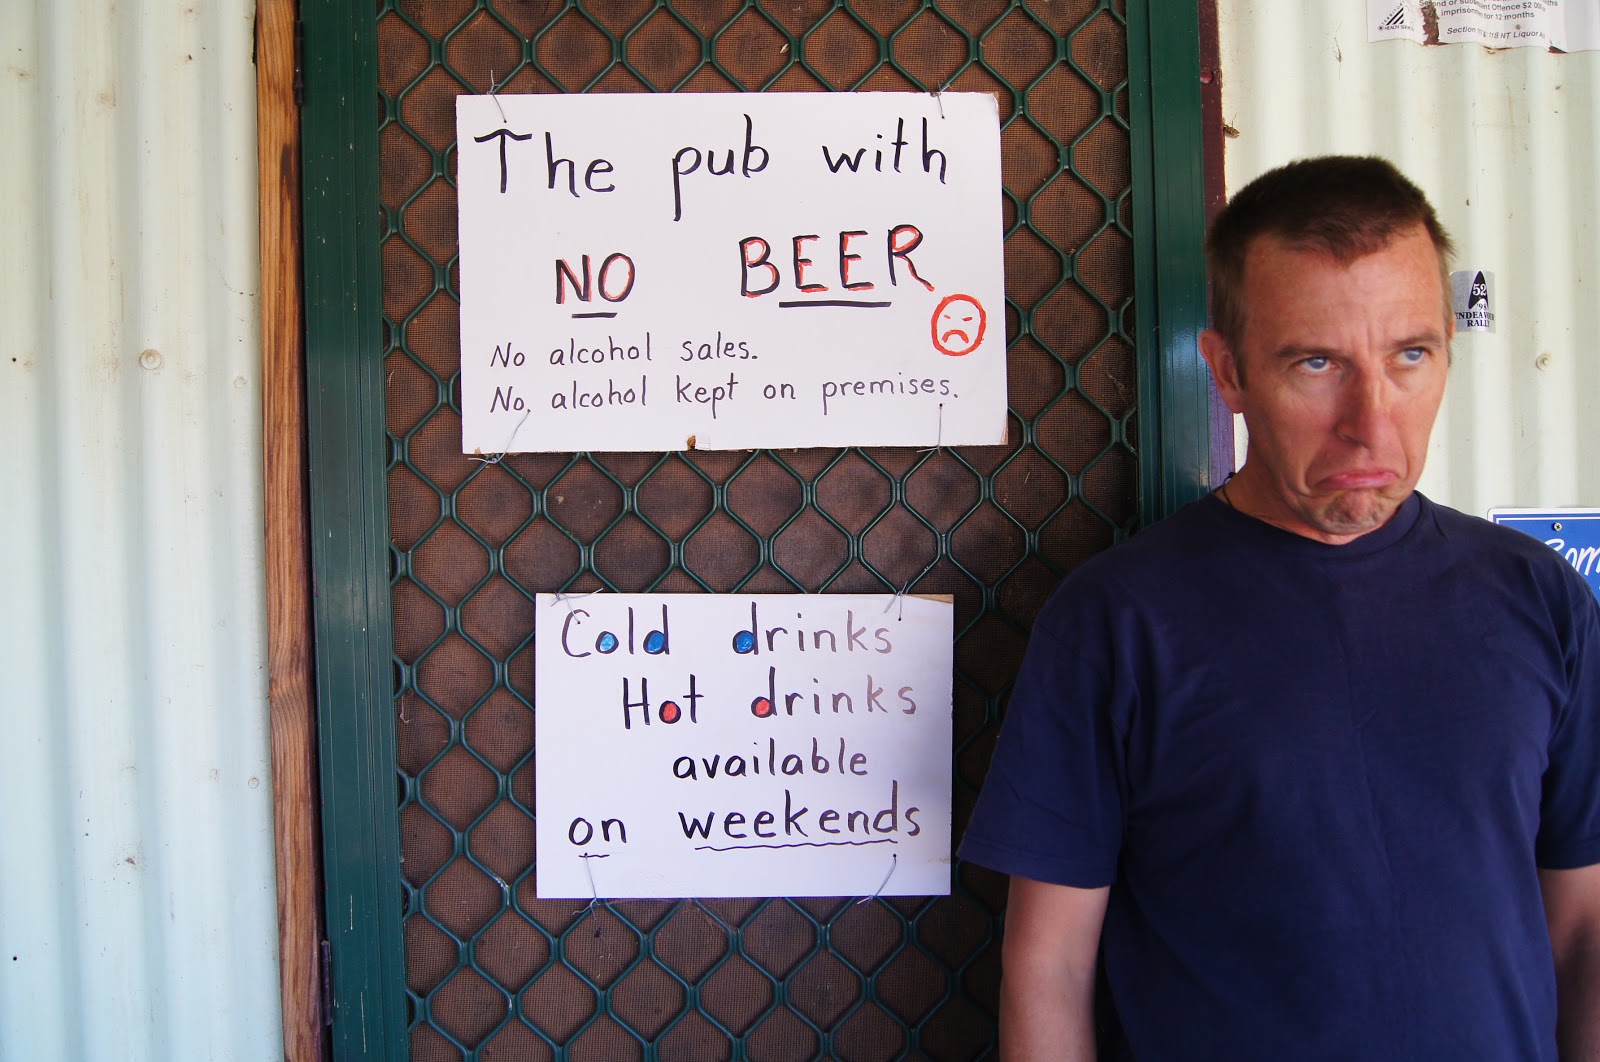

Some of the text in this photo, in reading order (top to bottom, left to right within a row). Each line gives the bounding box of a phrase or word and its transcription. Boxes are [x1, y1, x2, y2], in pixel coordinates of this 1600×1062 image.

[1447, 26, 1477, 35] Section
[1504, 11, 1535, 20] months
[474, 114, 946, 222] The pub with
[556, 224, 934, 304] NO BEER
[1472, 283, 1487, 296] 52
[491, 331, 757, 367] No alcohol sales.
[552, 375, 646, 409] alcohol
[677, 373, 738, 419] kept
[764, 384, 796, 399] on
[823, 374, 959, 415] premises.
[562, 602, 891, 657] Cold drinks
[623, 666, 916, 729] Hot drinks
[673, 737, 867, 780] available
[569, 780, 922, 845] on weekends
